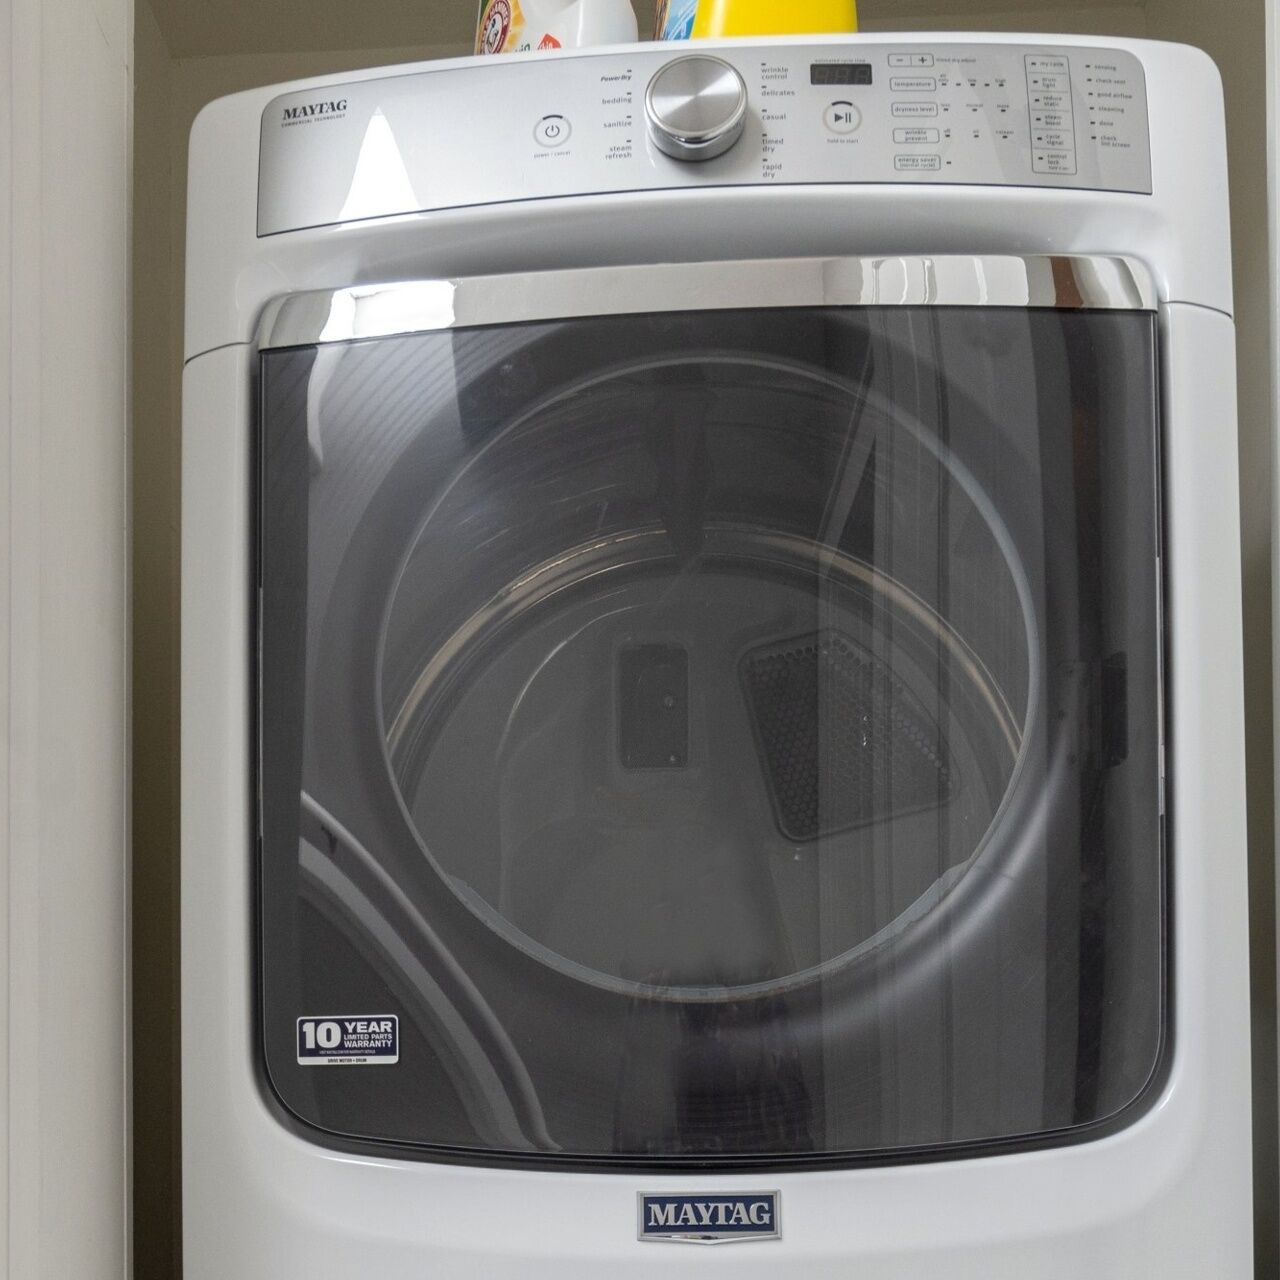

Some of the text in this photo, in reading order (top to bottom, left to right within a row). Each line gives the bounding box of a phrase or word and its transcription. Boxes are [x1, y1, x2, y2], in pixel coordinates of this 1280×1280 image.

[600, 74, 632, 82] PowerDry
[761, 89, 795, 97] delicates
[602, 97, 632, 105] bedding
[282, 99, 348, 121] MAYTAG
[762, 145, 775, 153] dry
[605, 152, 632, 160] refresh
[763, 163, 782, 171] rapid
[763, 171, 775, 179] dry
[302, 1021, 393, 1049] 10 YEAR
[343, 1039, 393, 1048] WARRANTY
[648, 1202, 771, 1226] MAYTAG
